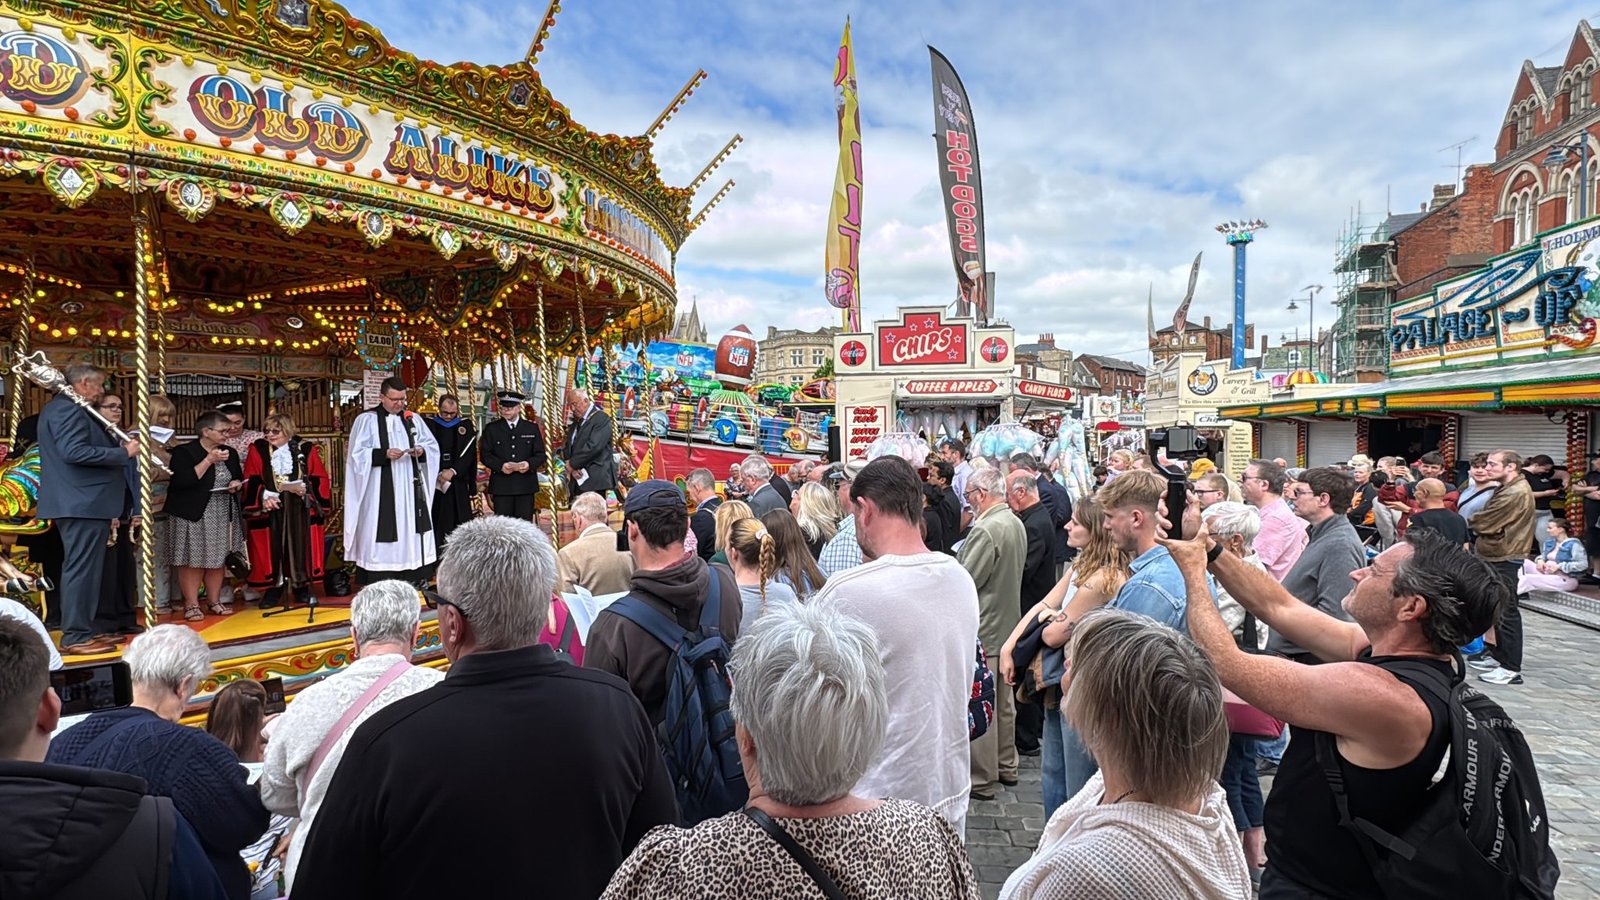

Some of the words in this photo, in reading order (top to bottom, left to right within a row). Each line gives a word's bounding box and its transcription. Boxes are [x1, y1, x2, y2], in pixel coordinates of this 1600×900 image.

[188, 74, 369, 163] OLD
[384, 122, 557, 214] ALIKE
[1388, 308, 1497, 353] PALACE
[368, 335, 391, 345] £4.00
[892, 327, 953, 363] CHIPS
[731, 353, 746, 365] NFL
[910, 381, 948, 393] TOFFEE
[949, 380, 993, 393] APPLES
[1222, 376, 1247, 386] Carvery
[1024, 382, 1047, 396] CANDY
[1046, 386, 1067, 399] FLOSS
[1241, 387, 1257, 395] Grill
[1463, 738, 1478, 816] ARMOUR
